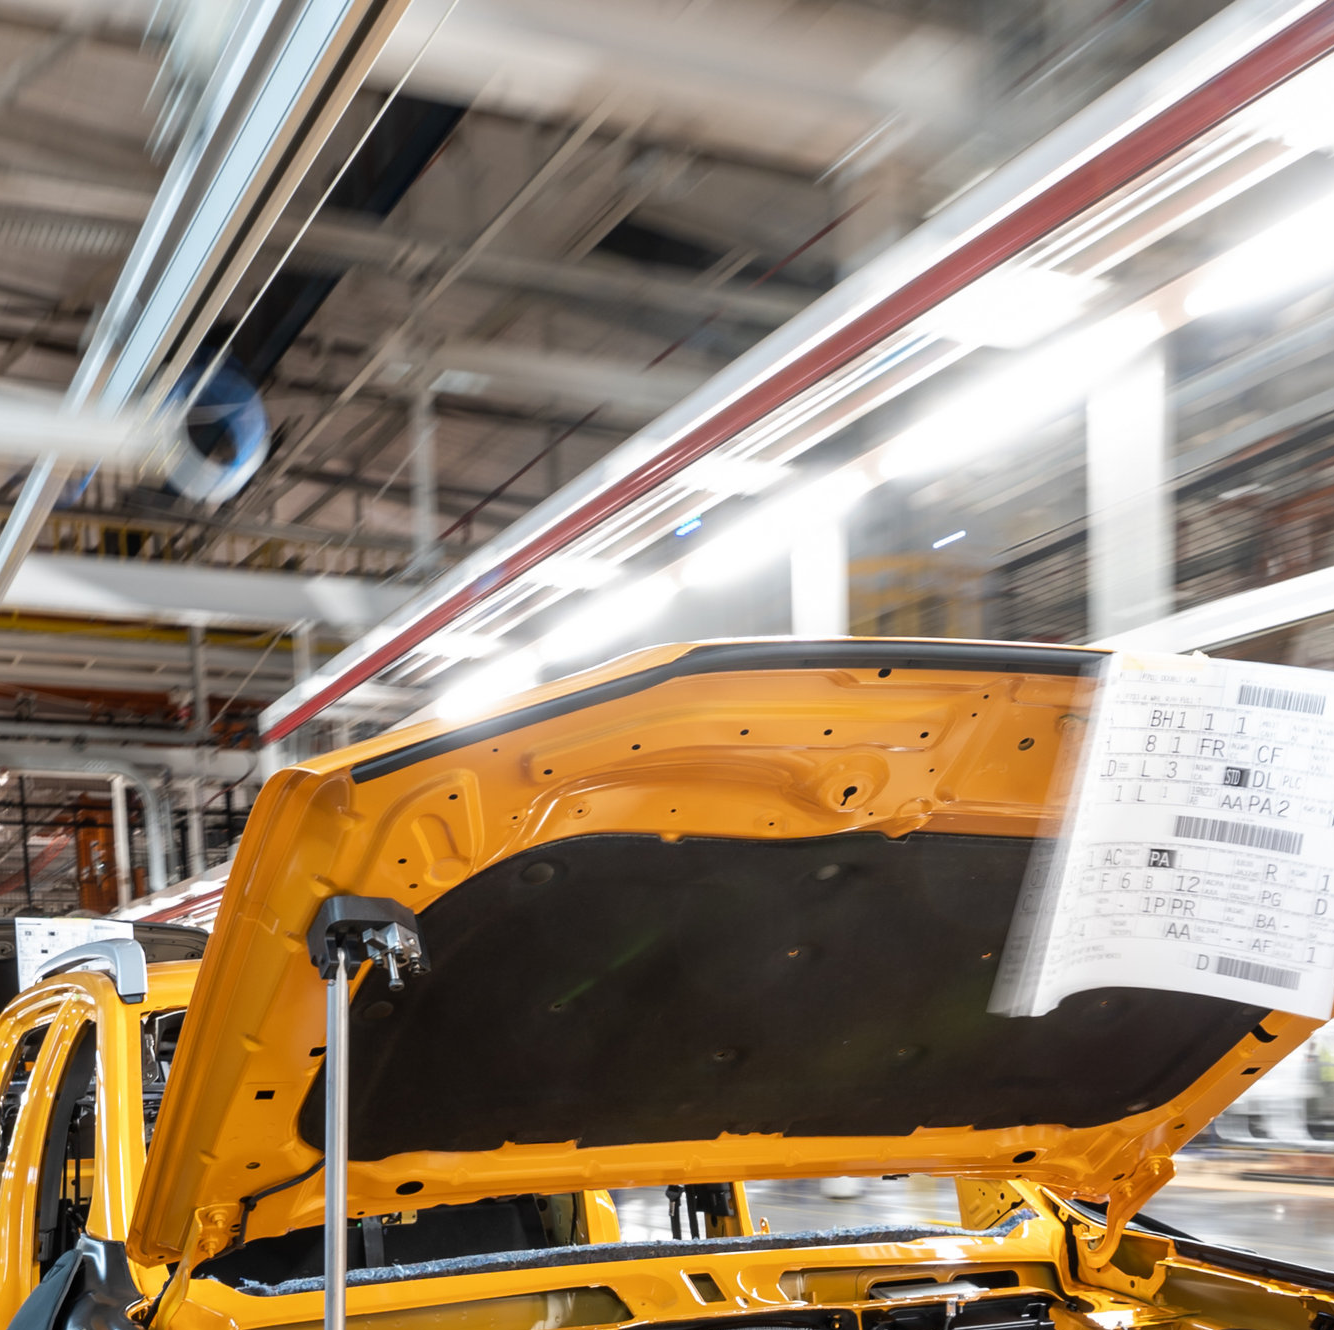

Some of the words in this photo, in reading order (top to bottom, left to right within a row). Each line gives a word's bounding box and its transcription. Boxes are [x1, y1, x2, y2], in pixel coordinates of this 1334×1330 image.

[1204, 712, 1214, 731] 1
[1236, 716, 1247, 735] 1
[1145, 734, 1157, 753] 8
[1171, 736, 1180, 754] 1
[1199, 738, 1226, 758] FR
[1257, 745, 1284, 764] CF
[1140, 760, 1151, 777] L
[1166, 761, 1178, 779] 3
[1225, 769, 1241, 785] STD
[1252, 770, 1276, 790] DL
[1136, 784, 1146, 802] L
[1220, 794, 1243, 811] AA
[1103, 848, 1122, 866] AC
[1149, 851, 1169, 867] PA
[1265, 863, 1278, 882] R
[1320, 874, 1330, 892] 1
[1101, 872, 1110, 890] F
[1121, 872, 1132, 889] 6
[1175, 875, 1201, 893] 12
[1260, 890, 1282, 907] PG
[1314, 898, 1328, 916] D
[1254, 914, 1277, 931] BA
[1164, 922, 1191, 940] AA
[1251, 938, 1273, 953] AF
[1306, 946, 1316, 964] 1
[1195, 953, 1210, 971] D
